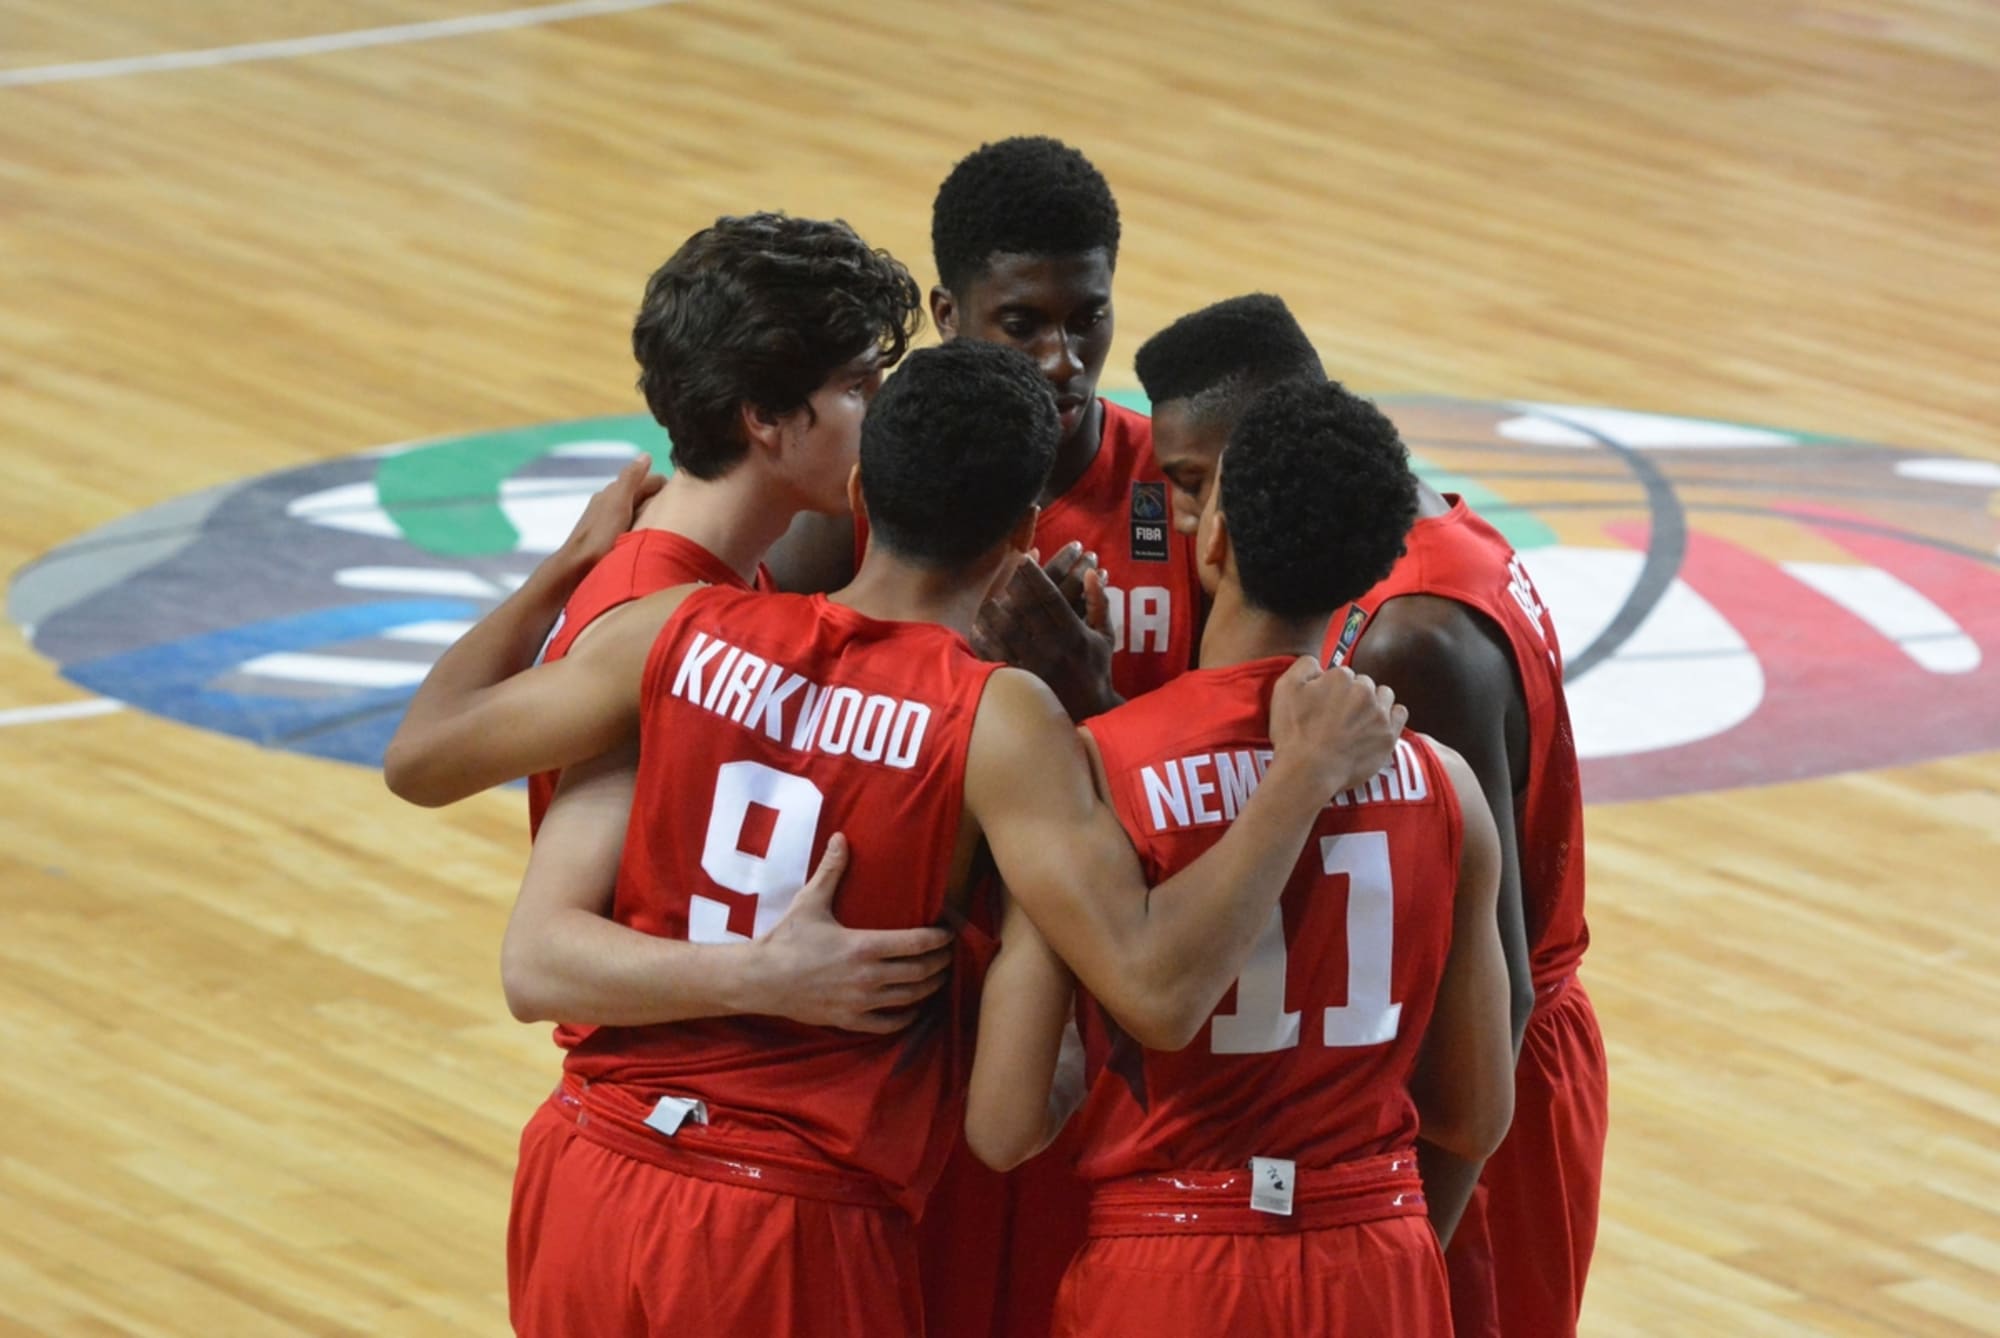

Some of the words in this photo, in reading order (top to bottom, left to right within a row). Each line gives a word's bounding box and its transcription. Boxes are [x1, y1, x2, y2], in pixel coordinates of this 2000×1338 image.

[1135, 526, 1162, 541] FIBA
[671, 631, 932, 770] KIRKWOOD
[688, 760, 824, 944] 9
[1140, 738, 1428, 831] NEMRD
[1210, 830, 1402, 1055] 11
